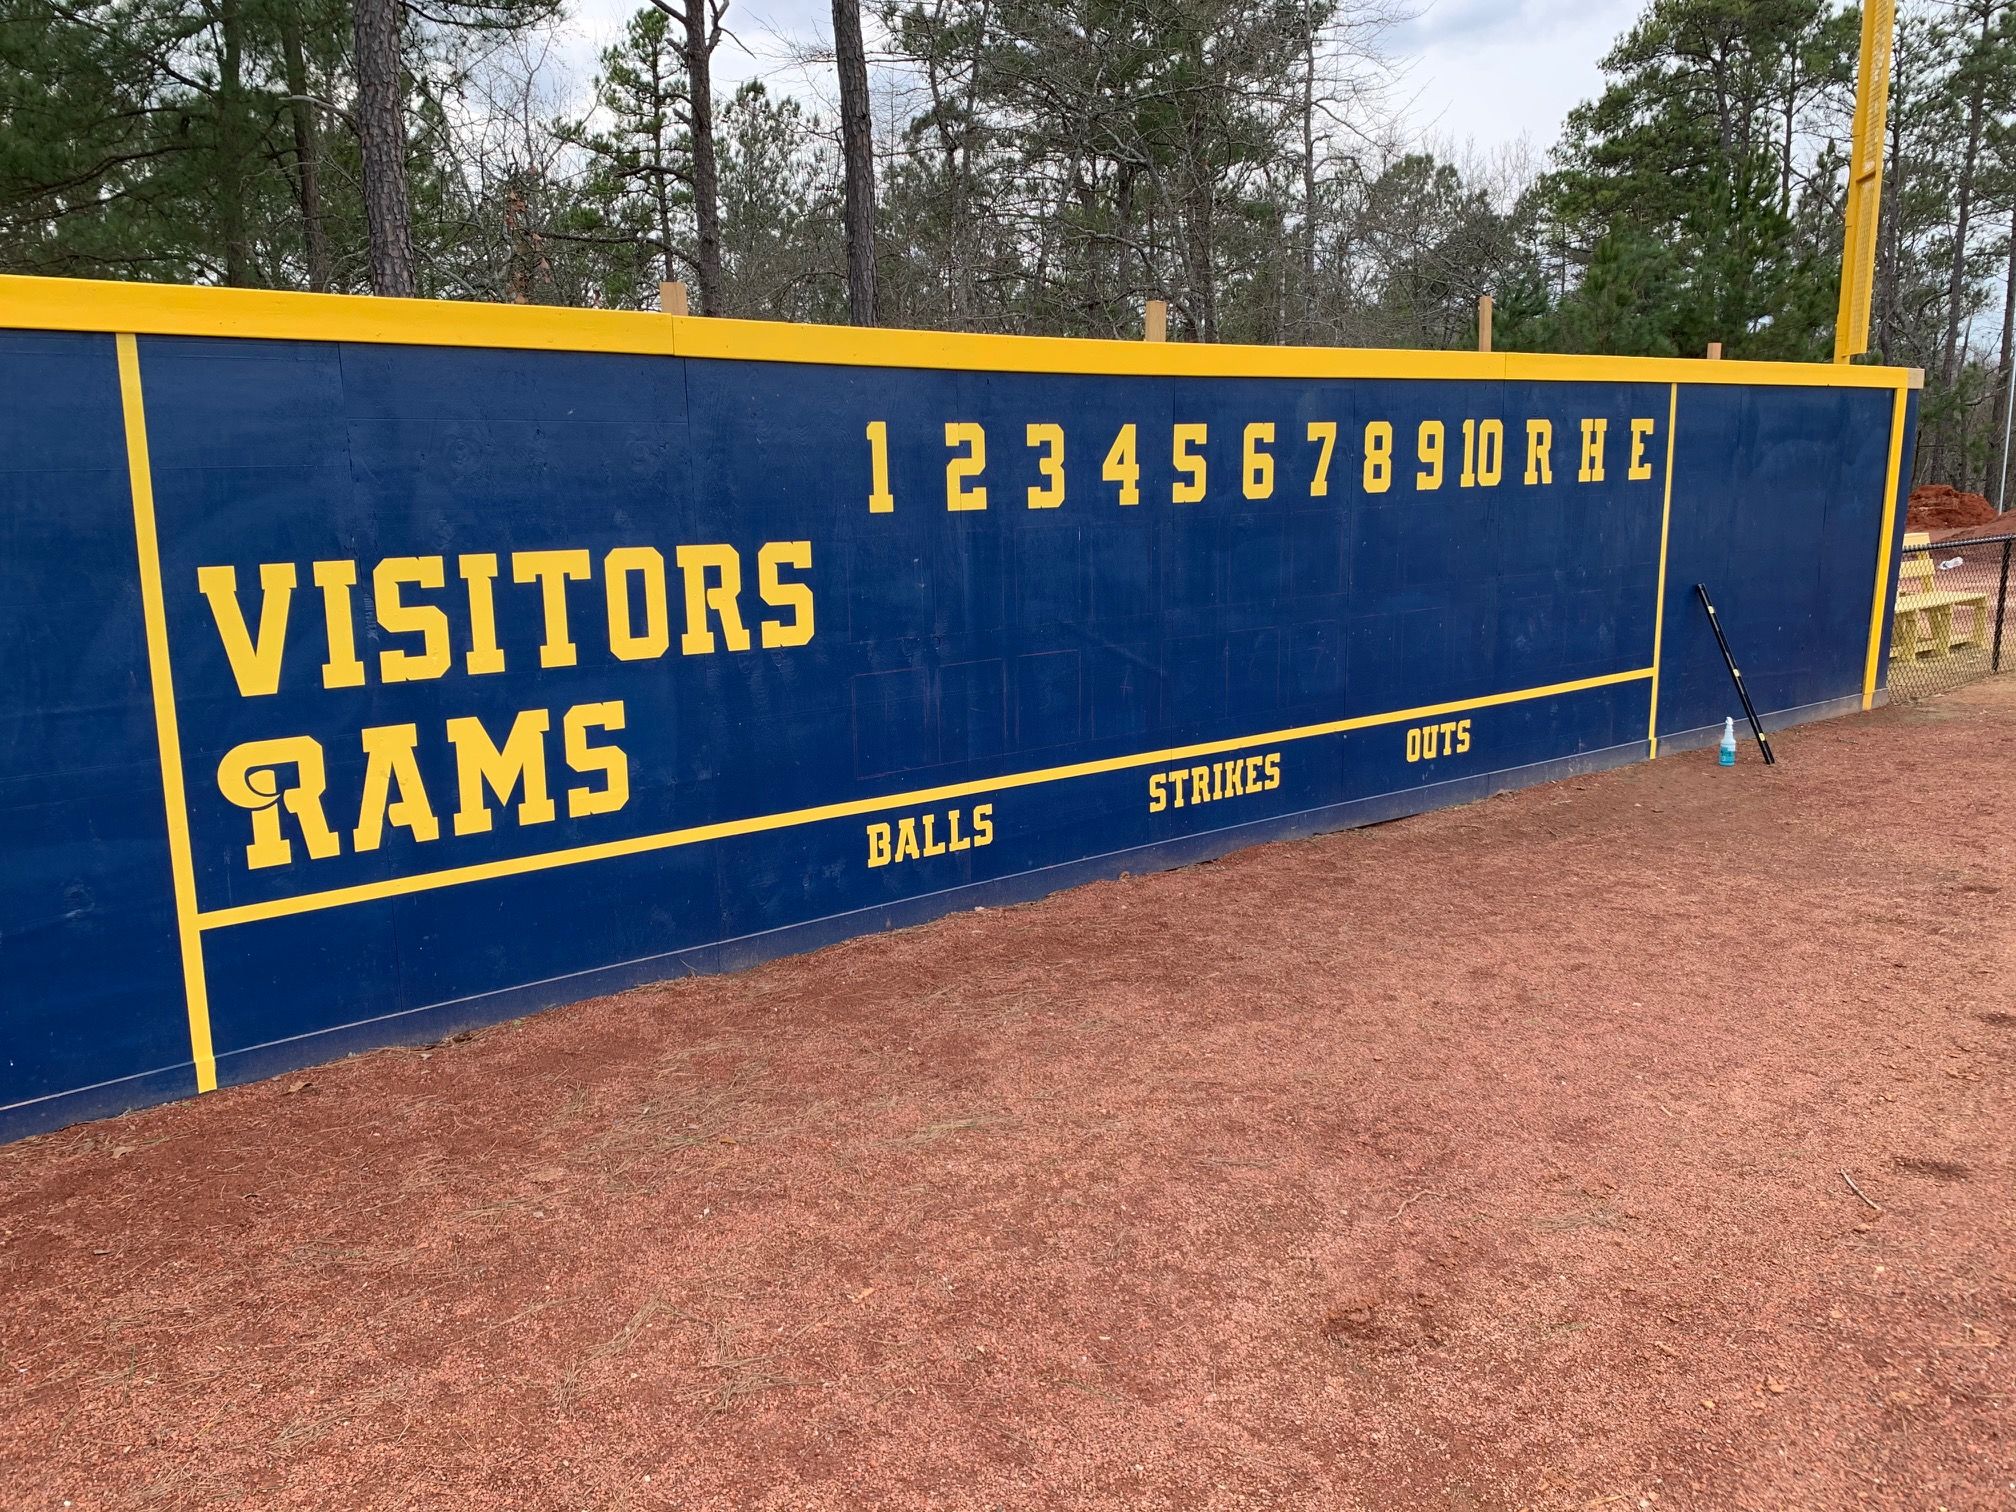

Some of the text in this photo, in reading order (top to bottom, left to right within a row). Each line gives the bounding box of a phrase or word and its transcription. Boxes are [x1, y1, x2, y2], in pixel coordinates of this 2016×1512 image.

[866, 418, 1655, 514] 1 2 3 4 5 6 7 8 9 10 R H E
[197, 540, 816, 698] VISITORS
[217, 699, 630, 870] RAMS
[866, 719, 1472, 869] BALLS STRIKES OUTS
